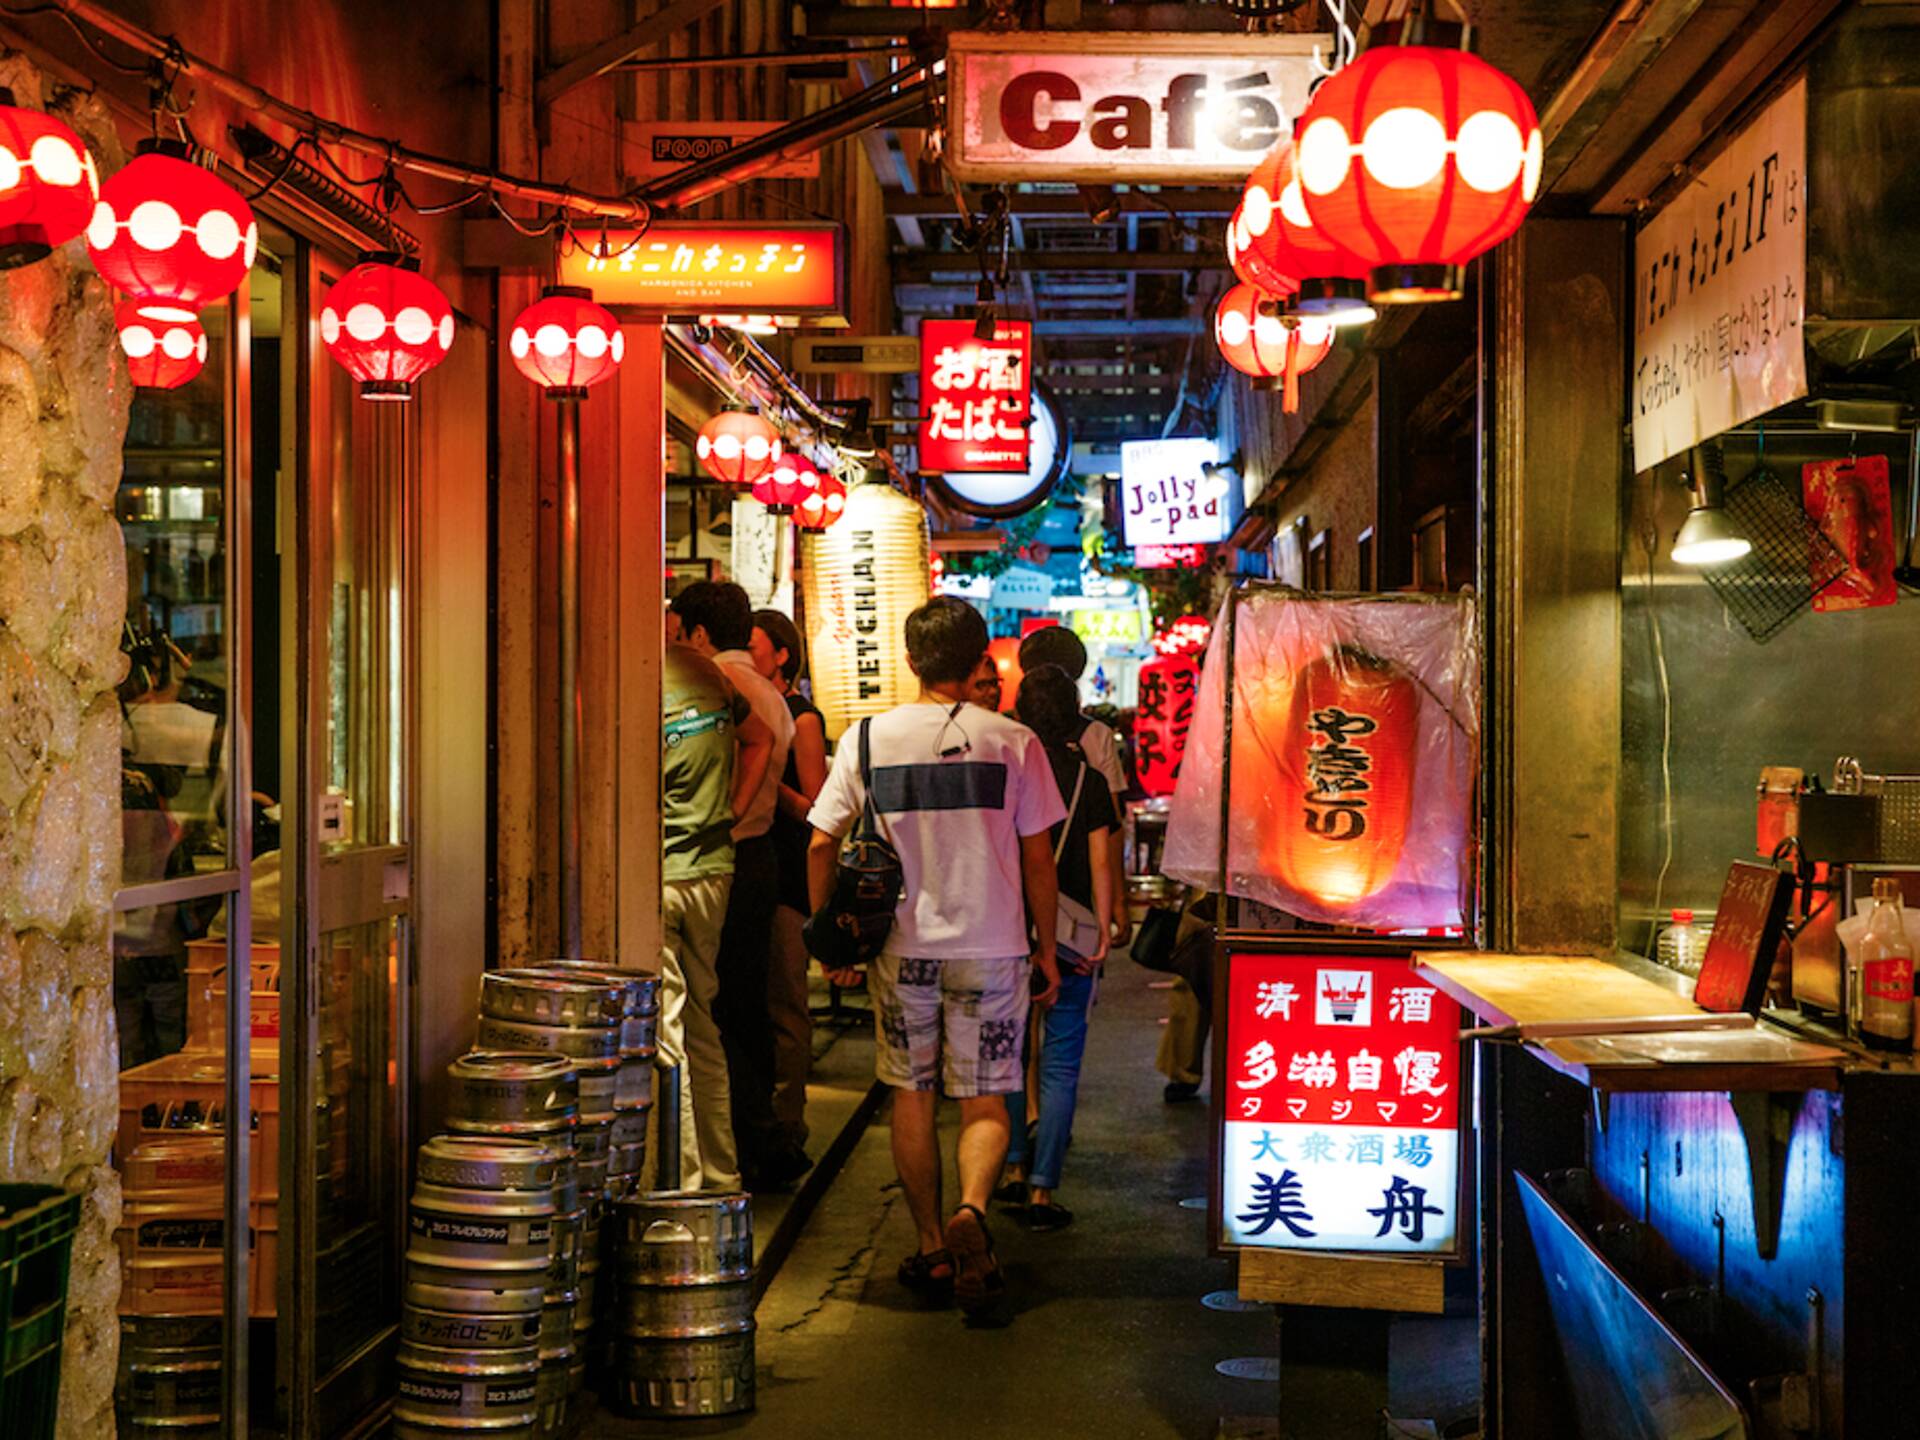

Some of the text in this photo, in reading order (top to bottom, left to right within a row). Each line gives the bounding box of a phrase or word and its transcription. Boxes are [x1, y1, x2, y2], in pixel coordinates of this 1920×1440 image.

[1000, 70, 1281, 151] Café
[655, 138, 729, 159] FOOD
[640, 279, 753, 287] HARMONICA KITCHEN
[931, 346, 1023, 391] お酒
[929, 396, 1025, 441] たばこ
[1130, 476, 1196, 515] Jolly
[852, 530, 881, 700] TETCHAN
[1240, 1097, 1444, 1123] タマジマン
[1250, 1129, 1435, 1169] 大衆酒場
[418, 1319, 515, 1341] サッポロビール
